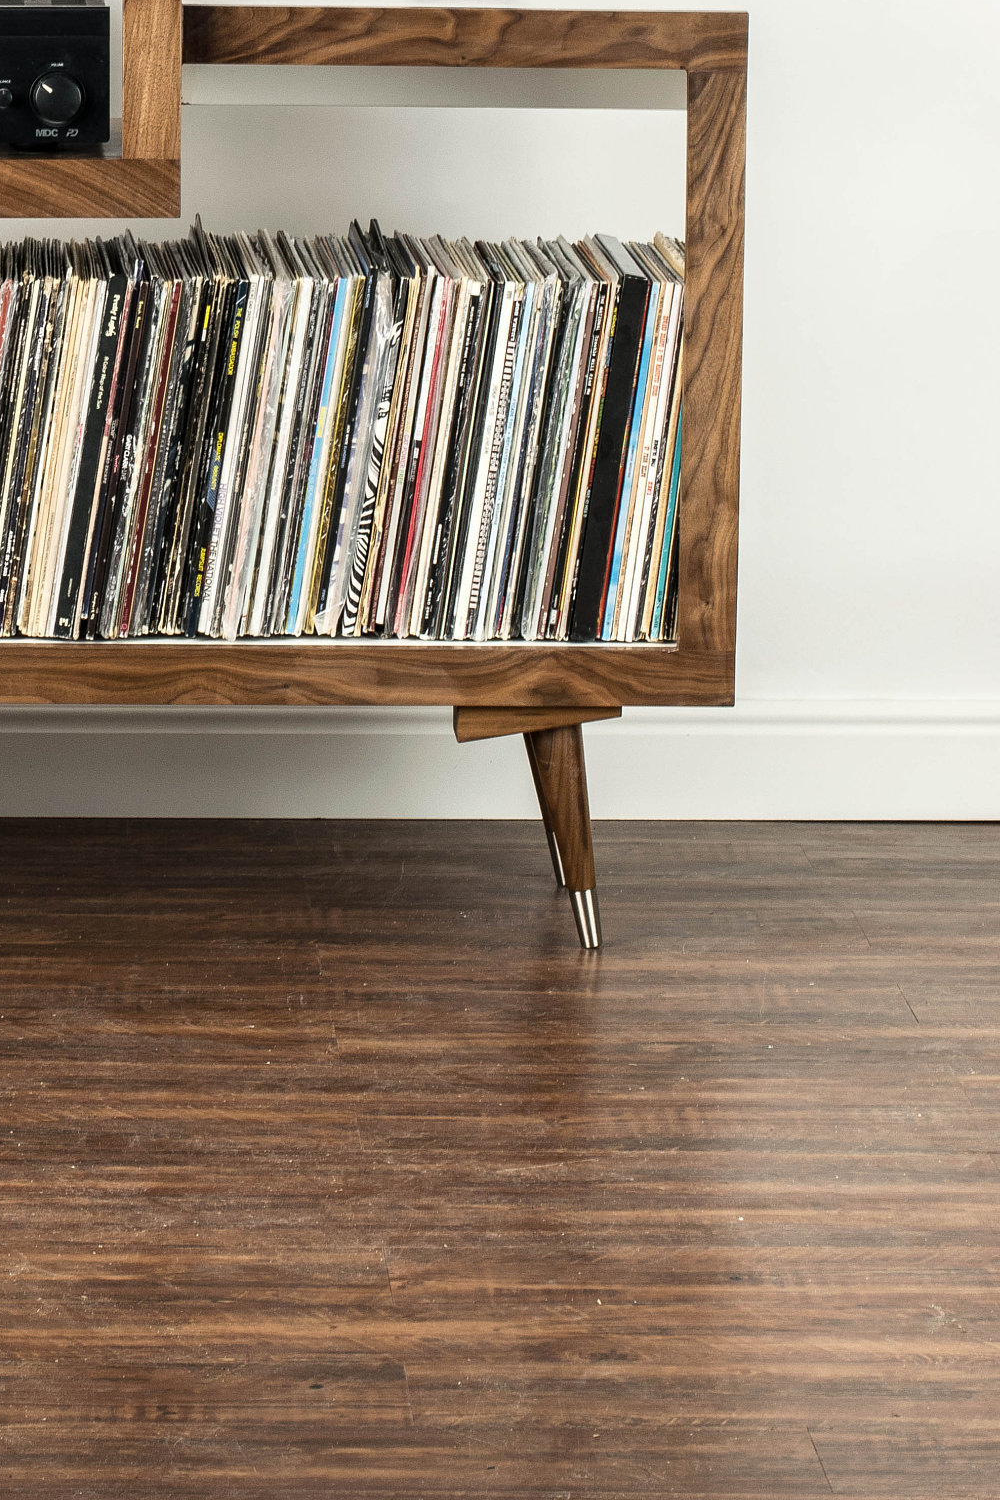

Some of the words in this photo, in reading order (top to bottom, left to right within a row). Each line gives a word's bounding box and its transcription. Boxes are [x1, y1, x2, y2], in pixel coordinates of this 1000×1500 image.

[35, 129, 58, 137] MDC
[109, 293, 120, 315] Pretty
[232, 319, 240, 338] POLISH
[226, 340, 237, 375] AMBASSADOR
[124, 433, 133, 450] GARY
[214, 431, 223, 462] DIPLOMATIC
[216, 482, 226, 504] HIGH
[211, 506, 223, 537] VIOLET
[208, 538, 218, 557] THE
[193, 573, 202, 597] RECORDS
[201, 558, 215, 603] NATIONAL
